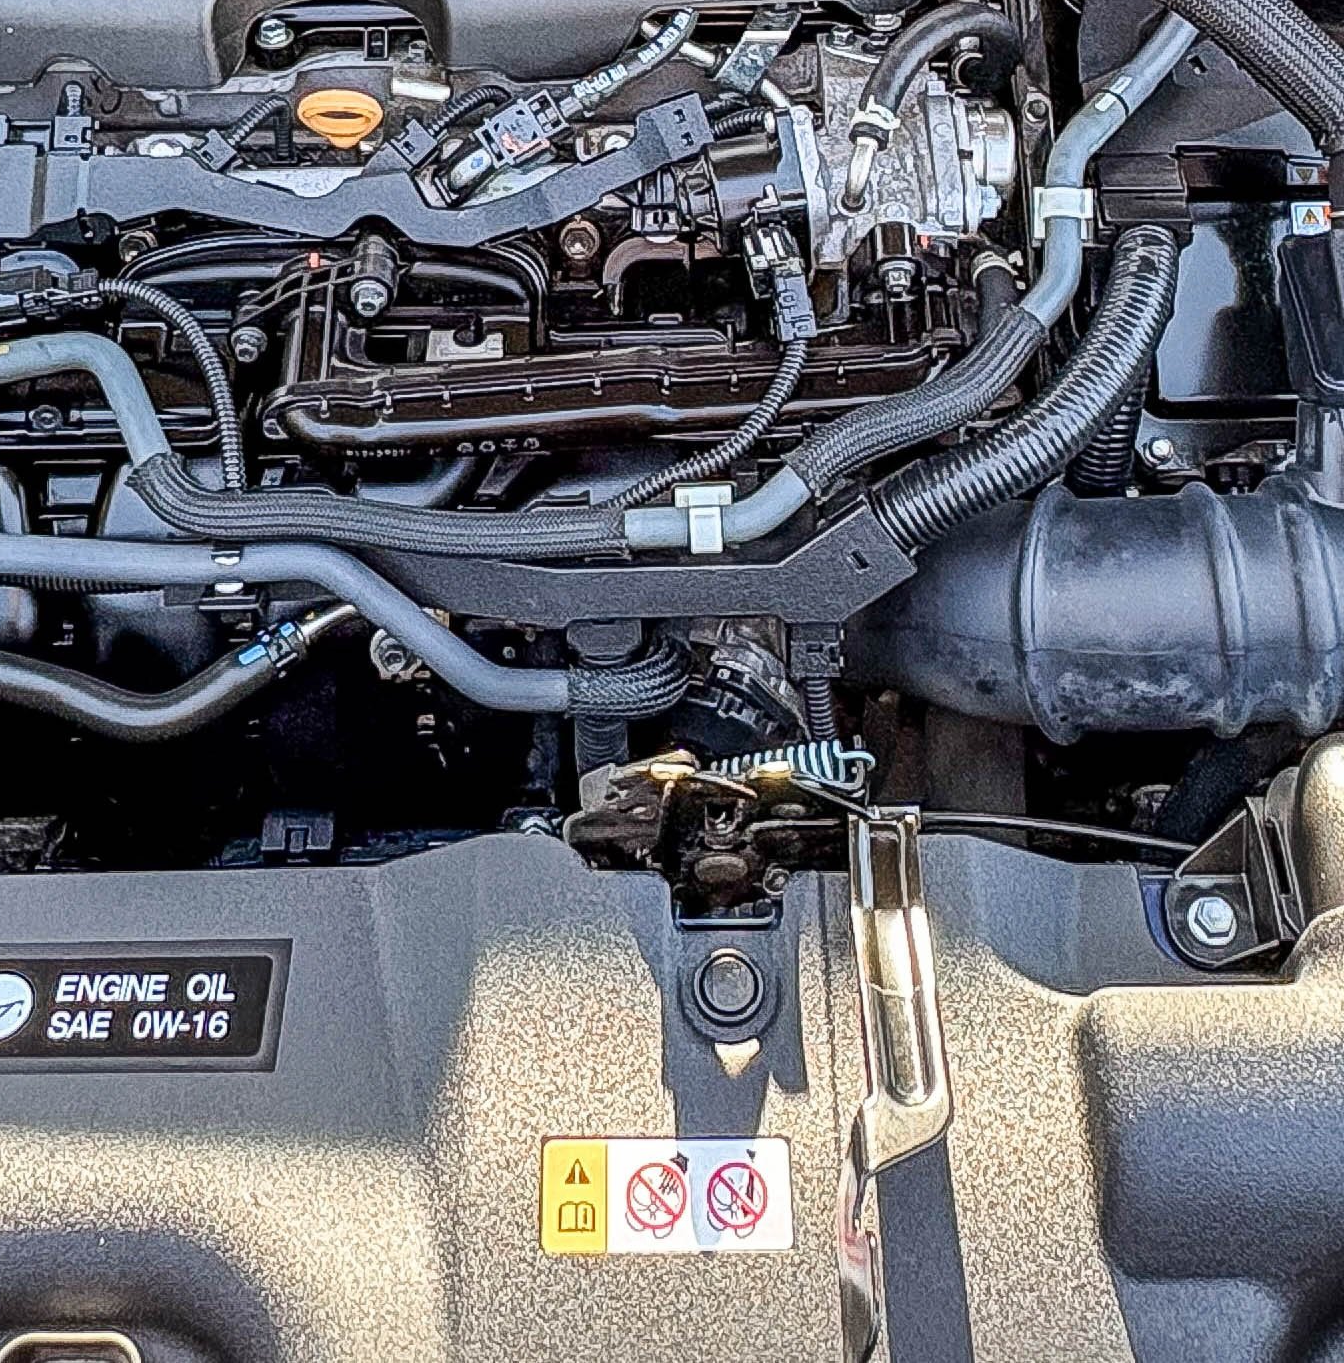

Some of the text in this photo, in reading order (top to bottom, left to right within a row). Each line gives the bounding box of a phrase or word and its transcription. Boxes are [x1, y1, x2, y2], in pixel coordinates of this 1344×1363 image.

[55, 972, 237, 1003] ENGINE OIL
[47, 1009, 231, 1040] SAE 0W-16
